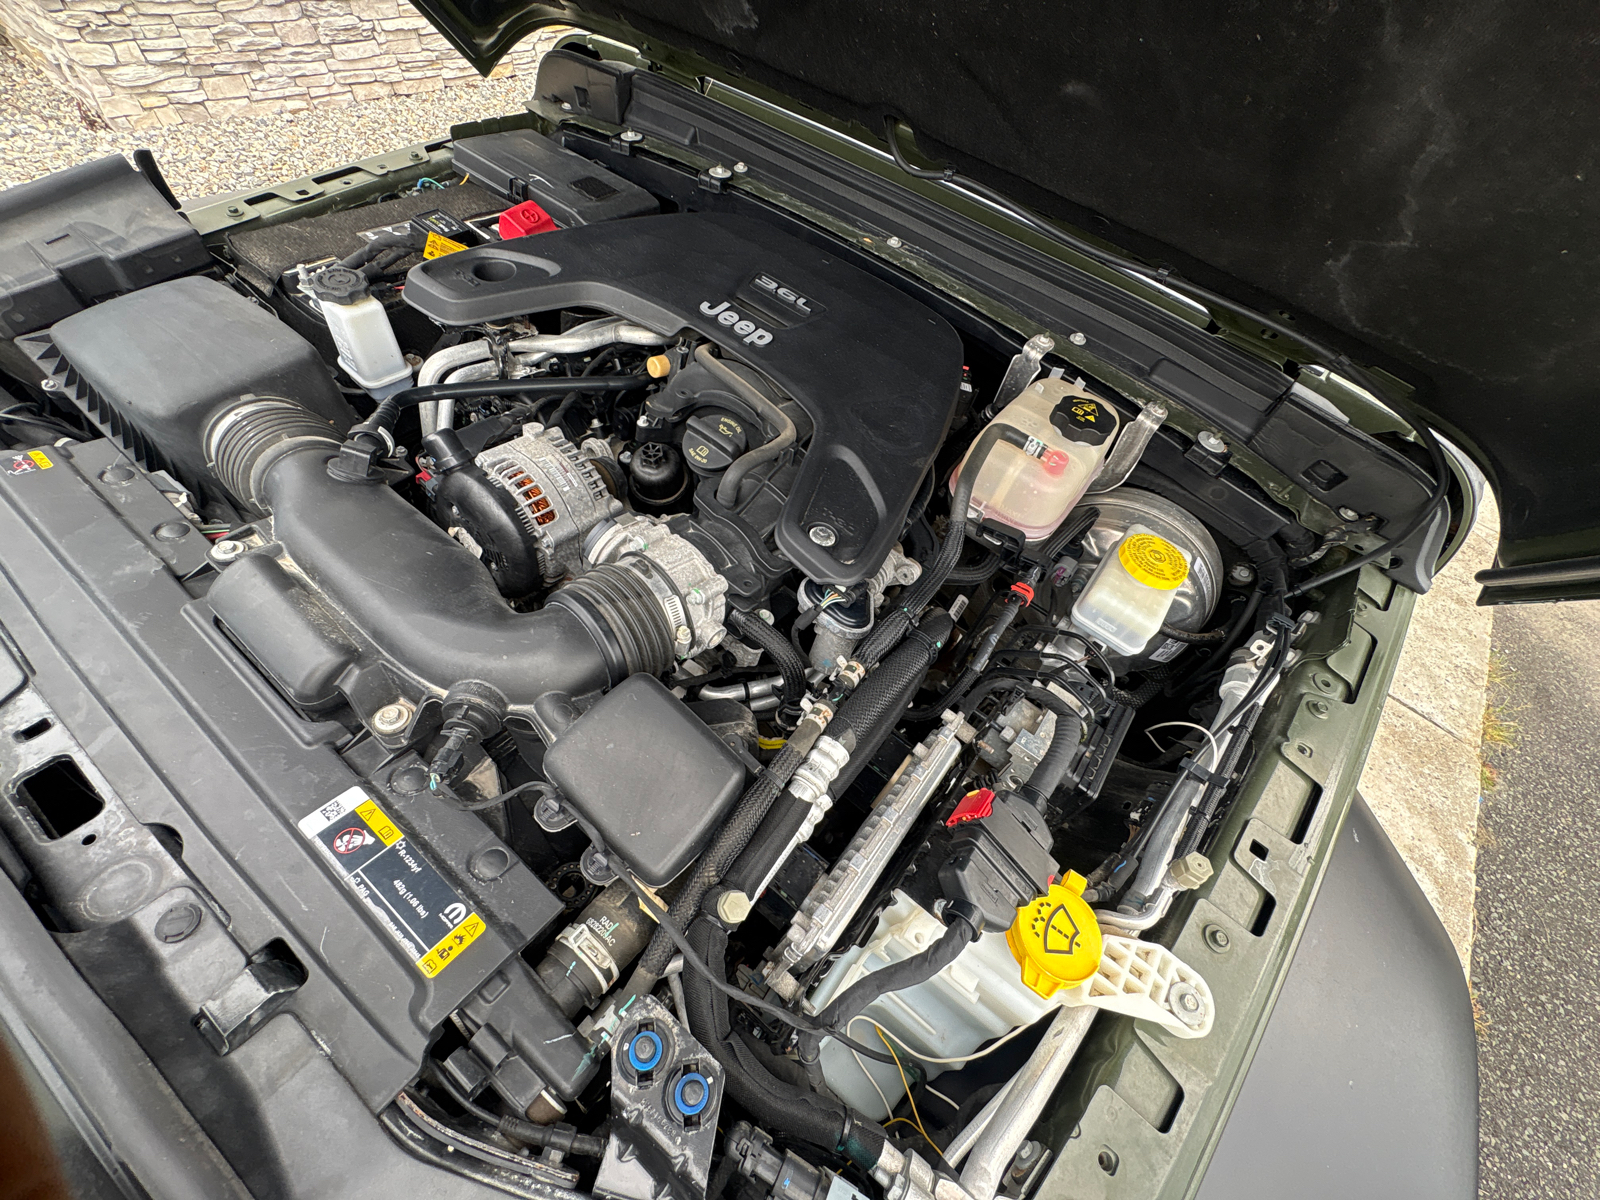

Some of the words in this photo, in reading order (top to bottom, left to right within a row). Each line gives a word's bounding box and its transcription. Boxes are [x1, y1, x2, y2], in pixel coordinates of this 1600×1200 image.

[755, 275, 811, 315] 3.6L
[699, 301, 773, 347] Jeep
[720, 417, 738, 428] ENGINE
[398, 849, 422, 873] R-1234yf
[393, 879, 407, 896] 482g
[403, 891, 420, 908] (1.06
[416, 904, 429, 919] lbs)
[600, 915, 613, 930] RAD
